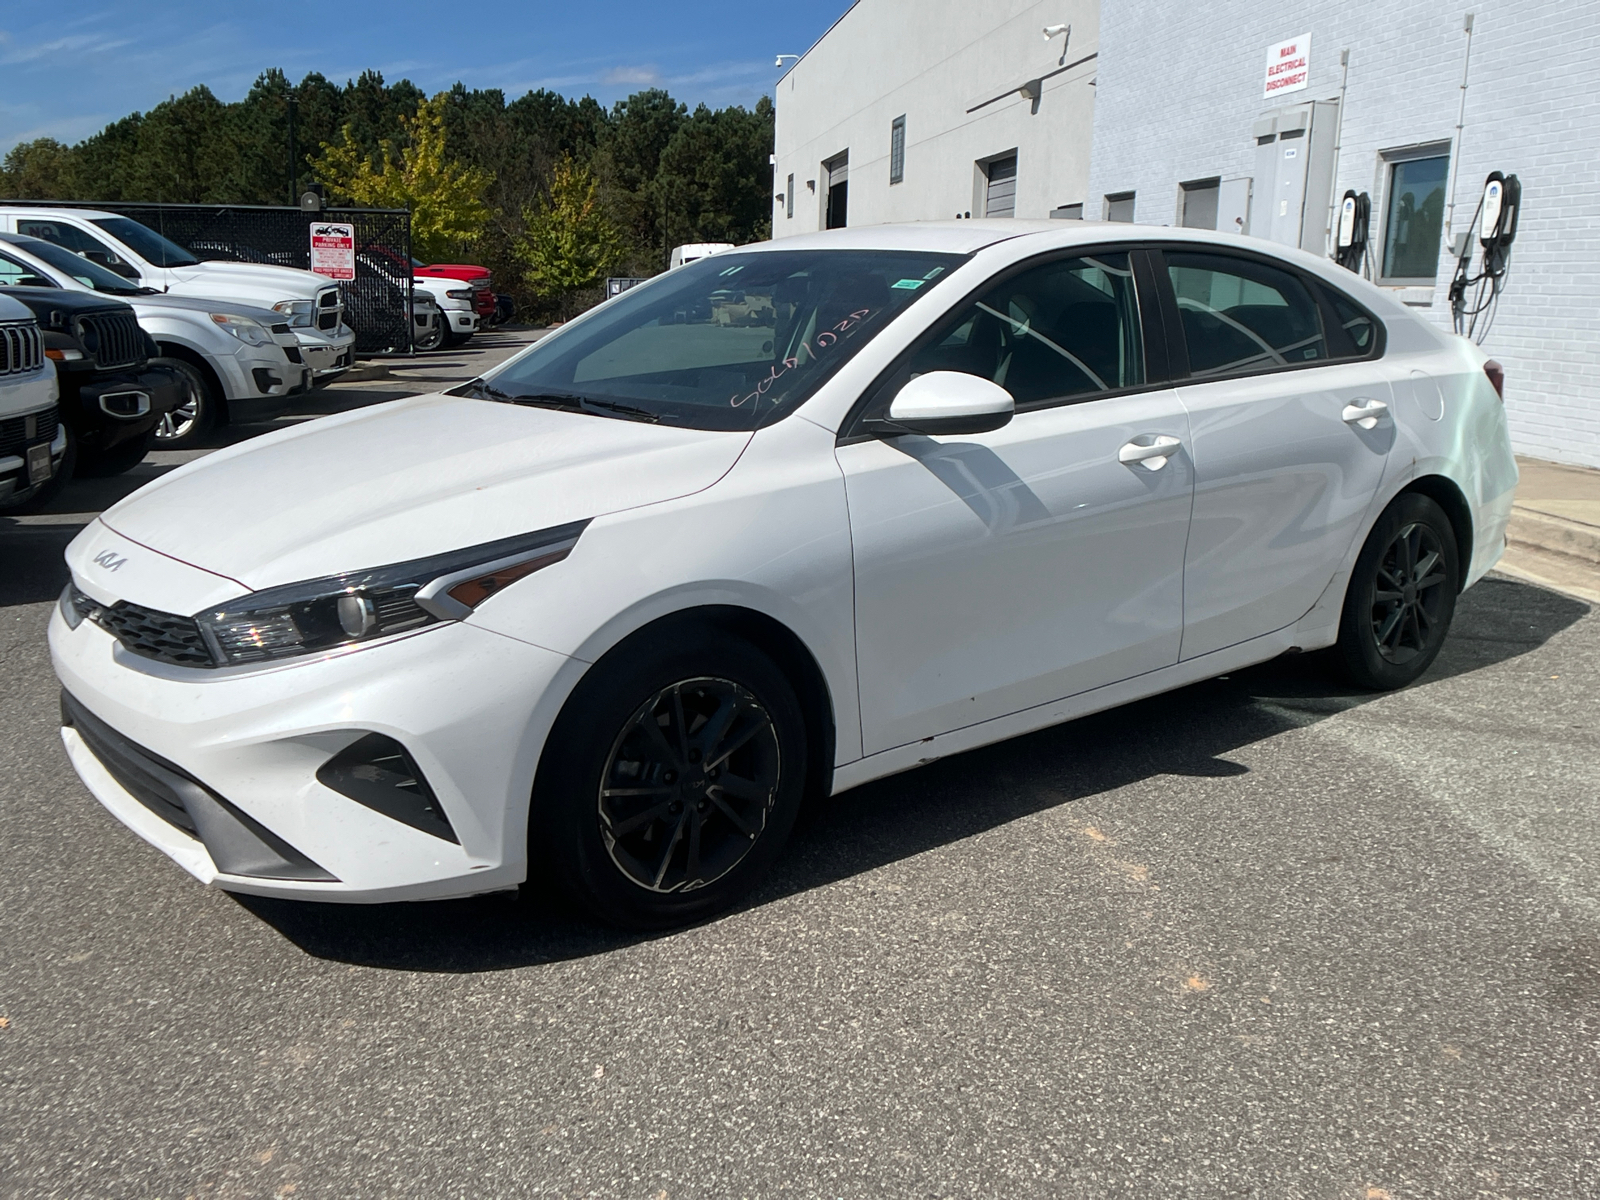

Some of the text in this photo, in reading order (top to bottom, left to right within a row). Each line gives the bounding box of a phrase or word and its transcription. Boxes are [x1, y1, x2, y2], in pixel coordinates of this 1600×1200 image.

[1280, 44, 1297, 58] MAIN
[1268, 57, 1306, 76] ELECTRICAL
[1266, 72, 1307, 91] DISCONNECT
